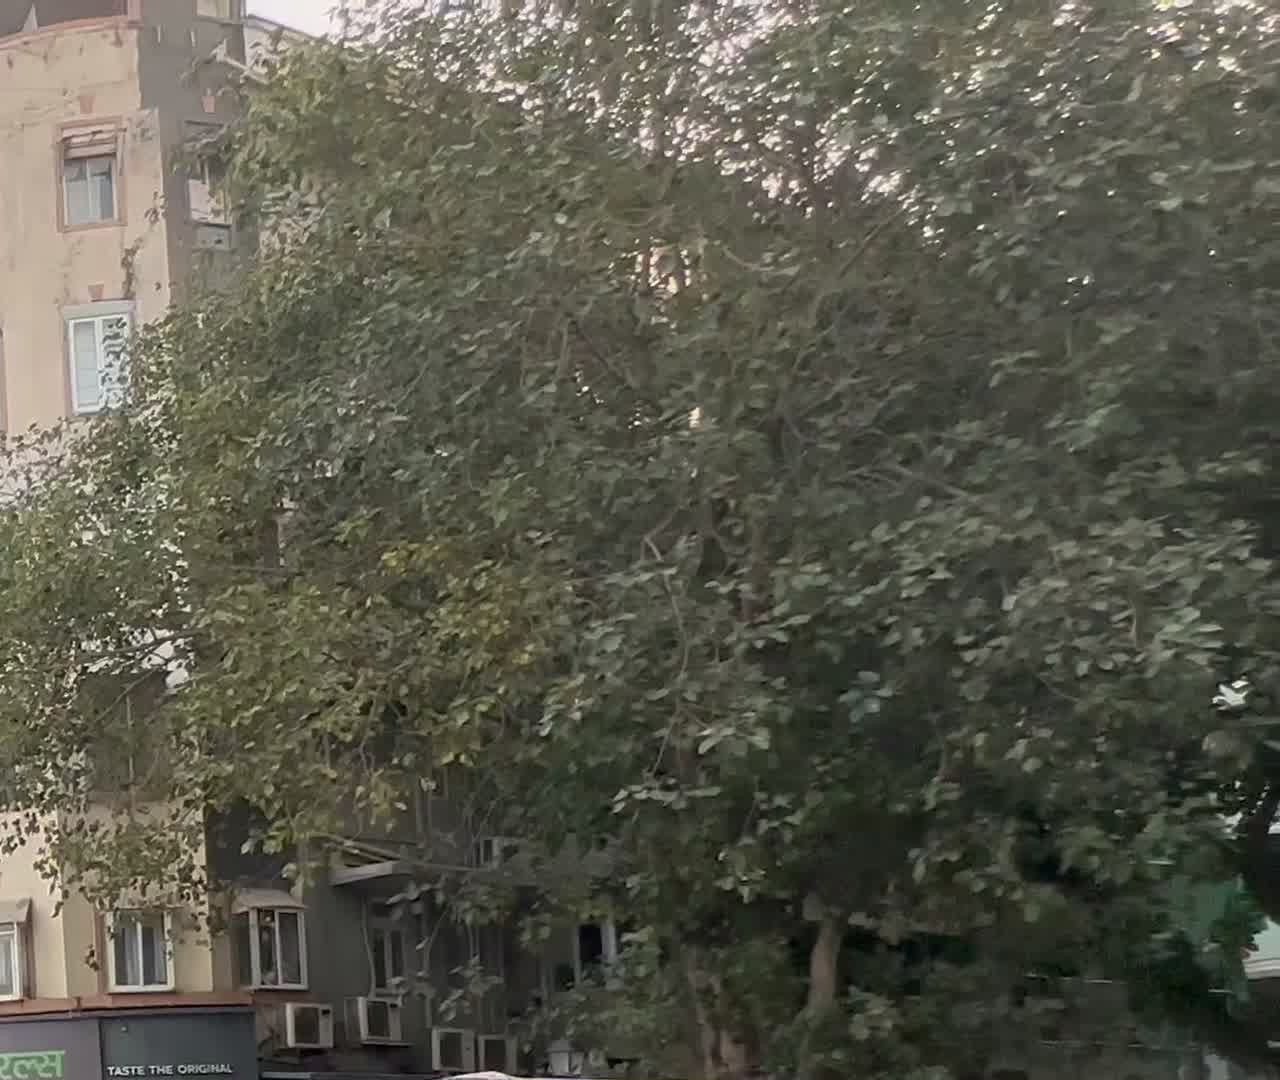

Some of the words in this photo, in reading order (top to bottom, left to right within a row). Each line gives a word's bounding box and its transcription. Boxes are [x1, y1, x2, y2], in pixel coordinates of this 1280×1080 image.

[107, 1065, 145, 1076] TASTE
[148, 1064, 173, 1075] THE
[177, 1063, 233, 1075] ORIGINAL
